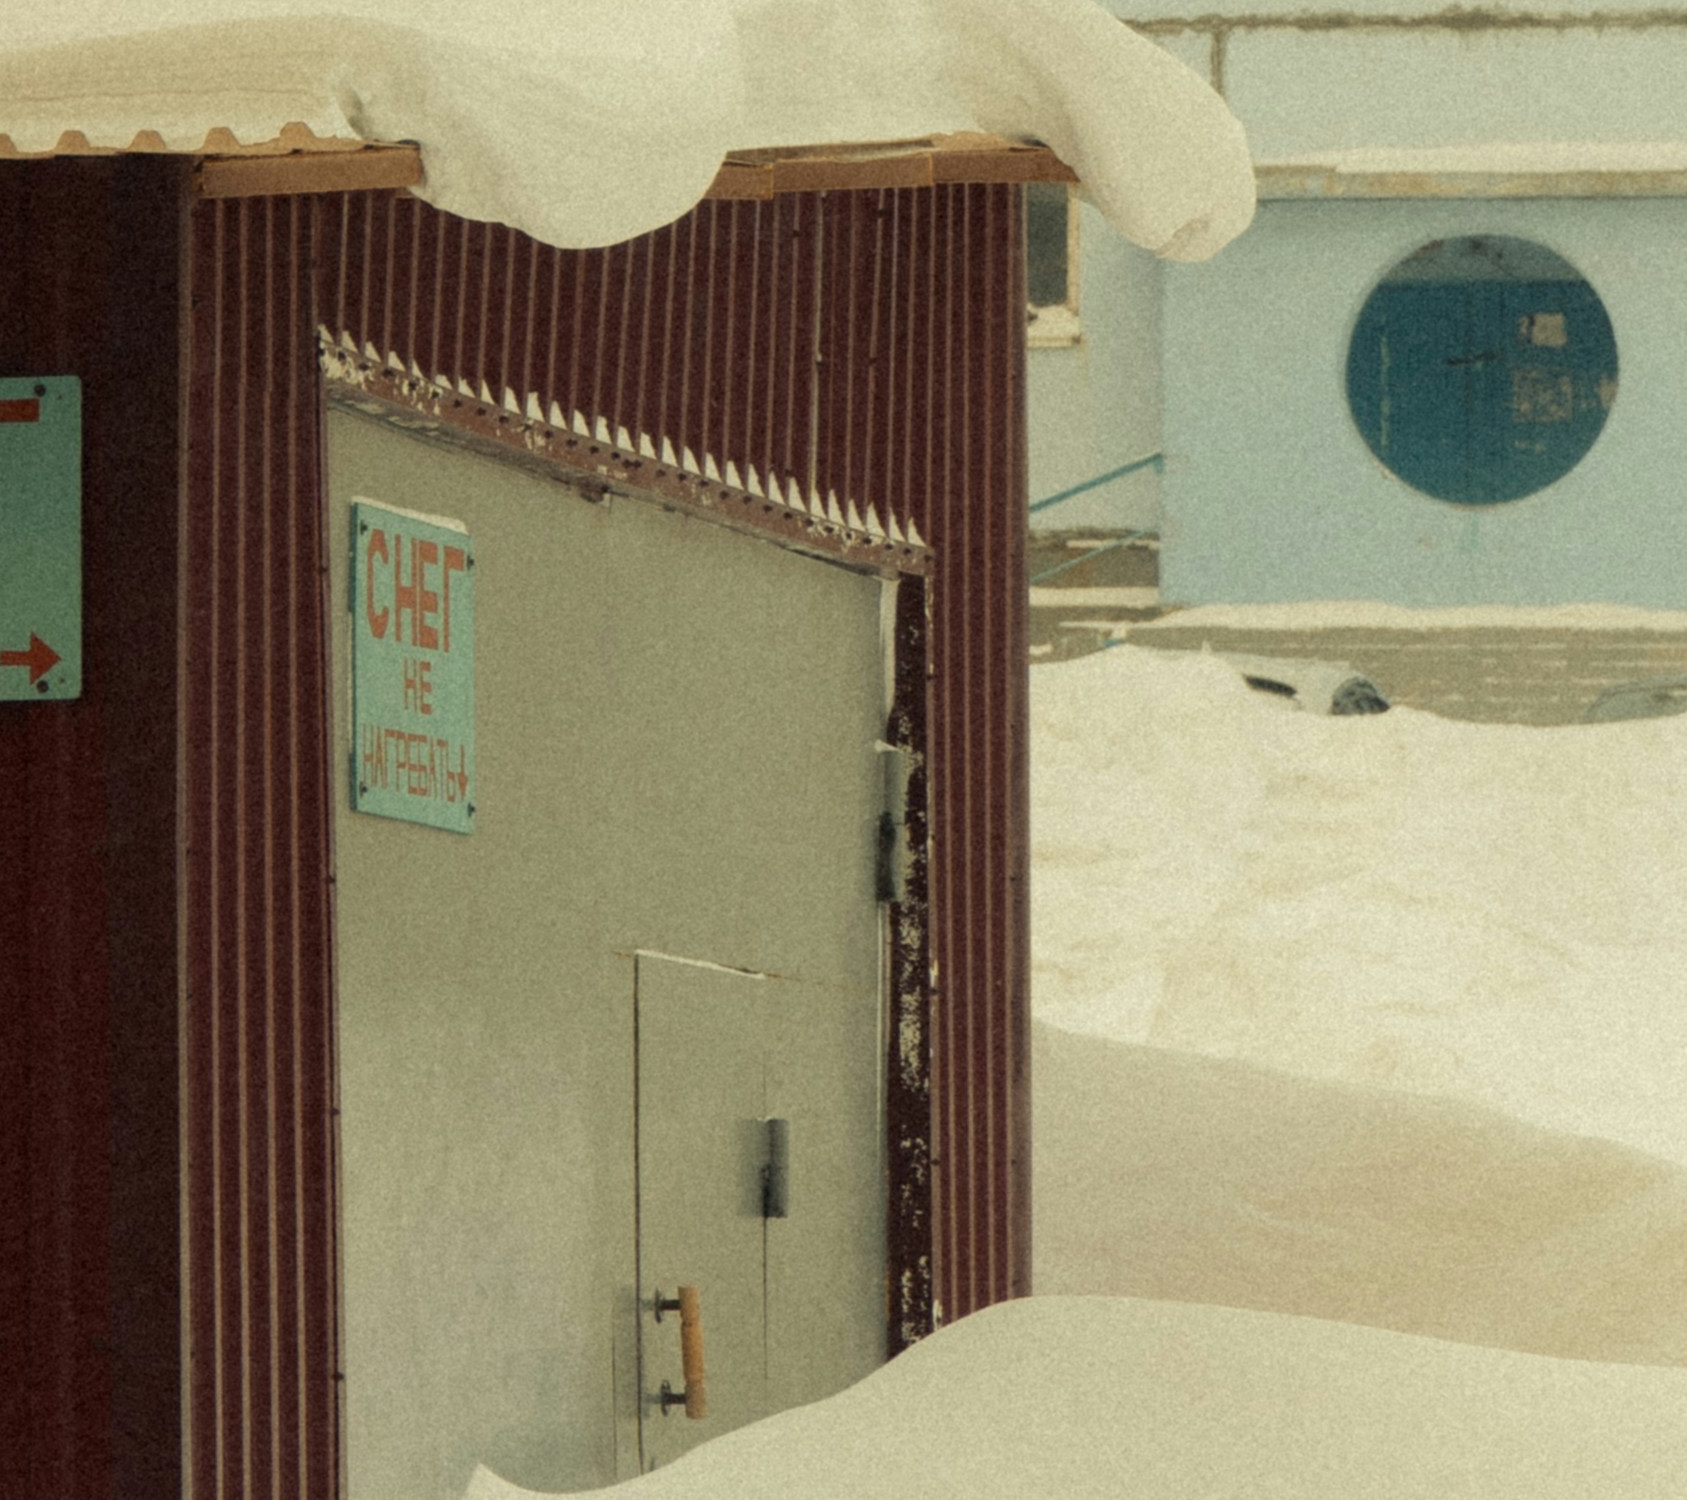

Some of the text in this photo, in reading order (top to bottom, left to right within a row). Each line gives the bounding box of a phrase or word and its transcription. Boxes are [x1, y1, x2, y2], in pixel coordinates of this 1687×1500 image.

[366, 529, 464, 653] СНЕГ
[404, 658, 432, 715] НЕ
[363, 723, 456, 803] НАГРЕБАТЬ
